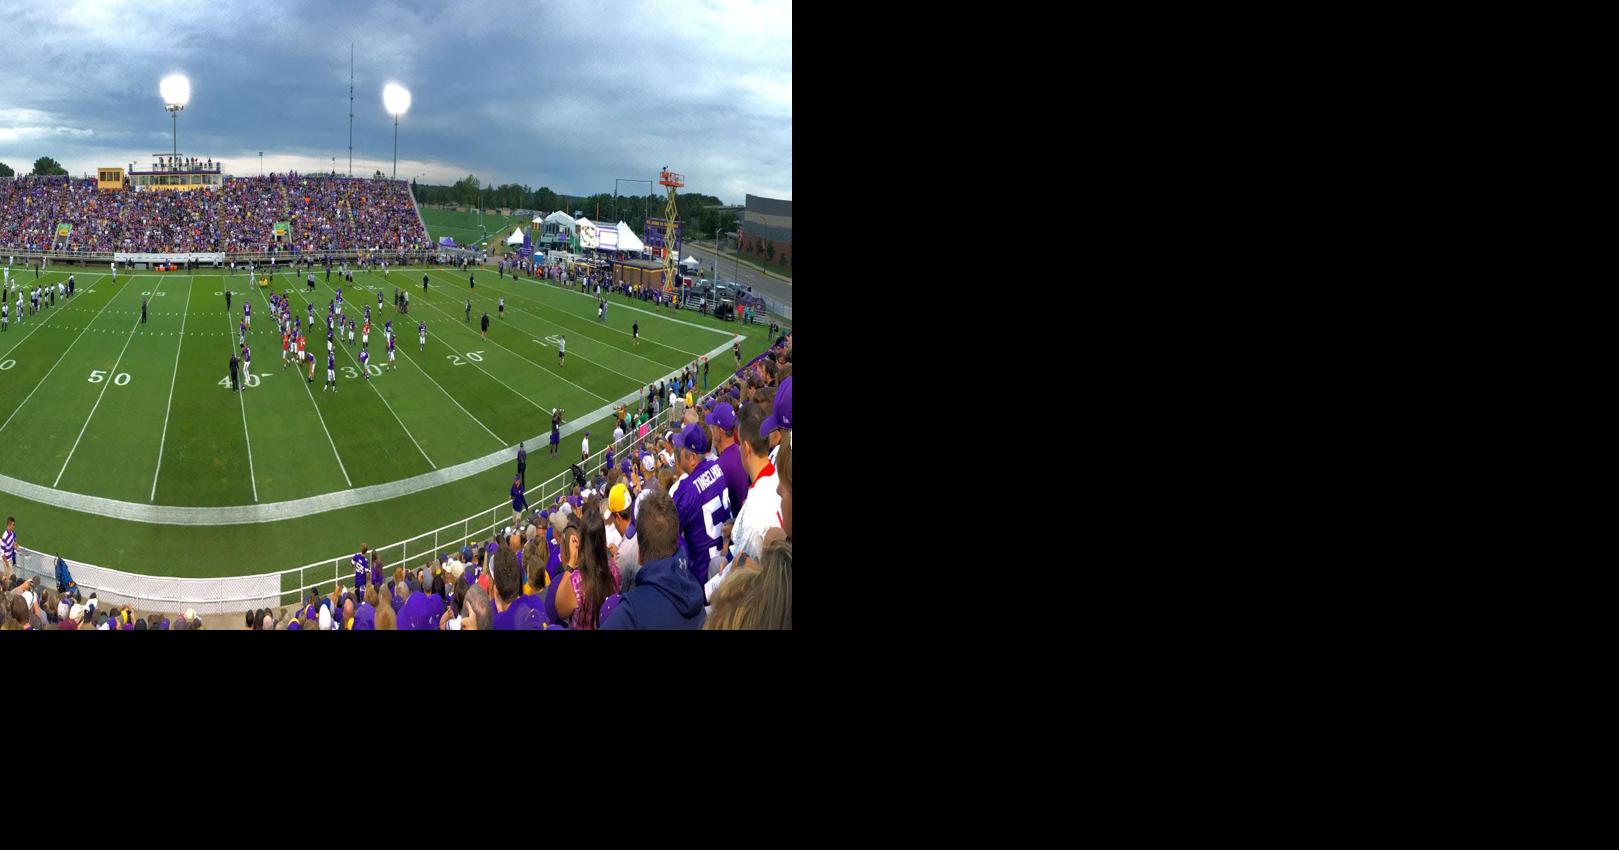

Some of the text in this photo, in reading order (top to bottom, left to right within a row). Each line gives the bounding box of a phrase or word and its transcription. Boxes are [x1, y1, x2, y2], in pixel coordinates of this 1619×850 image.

[446, 352, 484, 366] 20
[87, 370, 131, 386] 50
[340, 365, 382, 379] 30
[217, 374, 261, 389] 40
